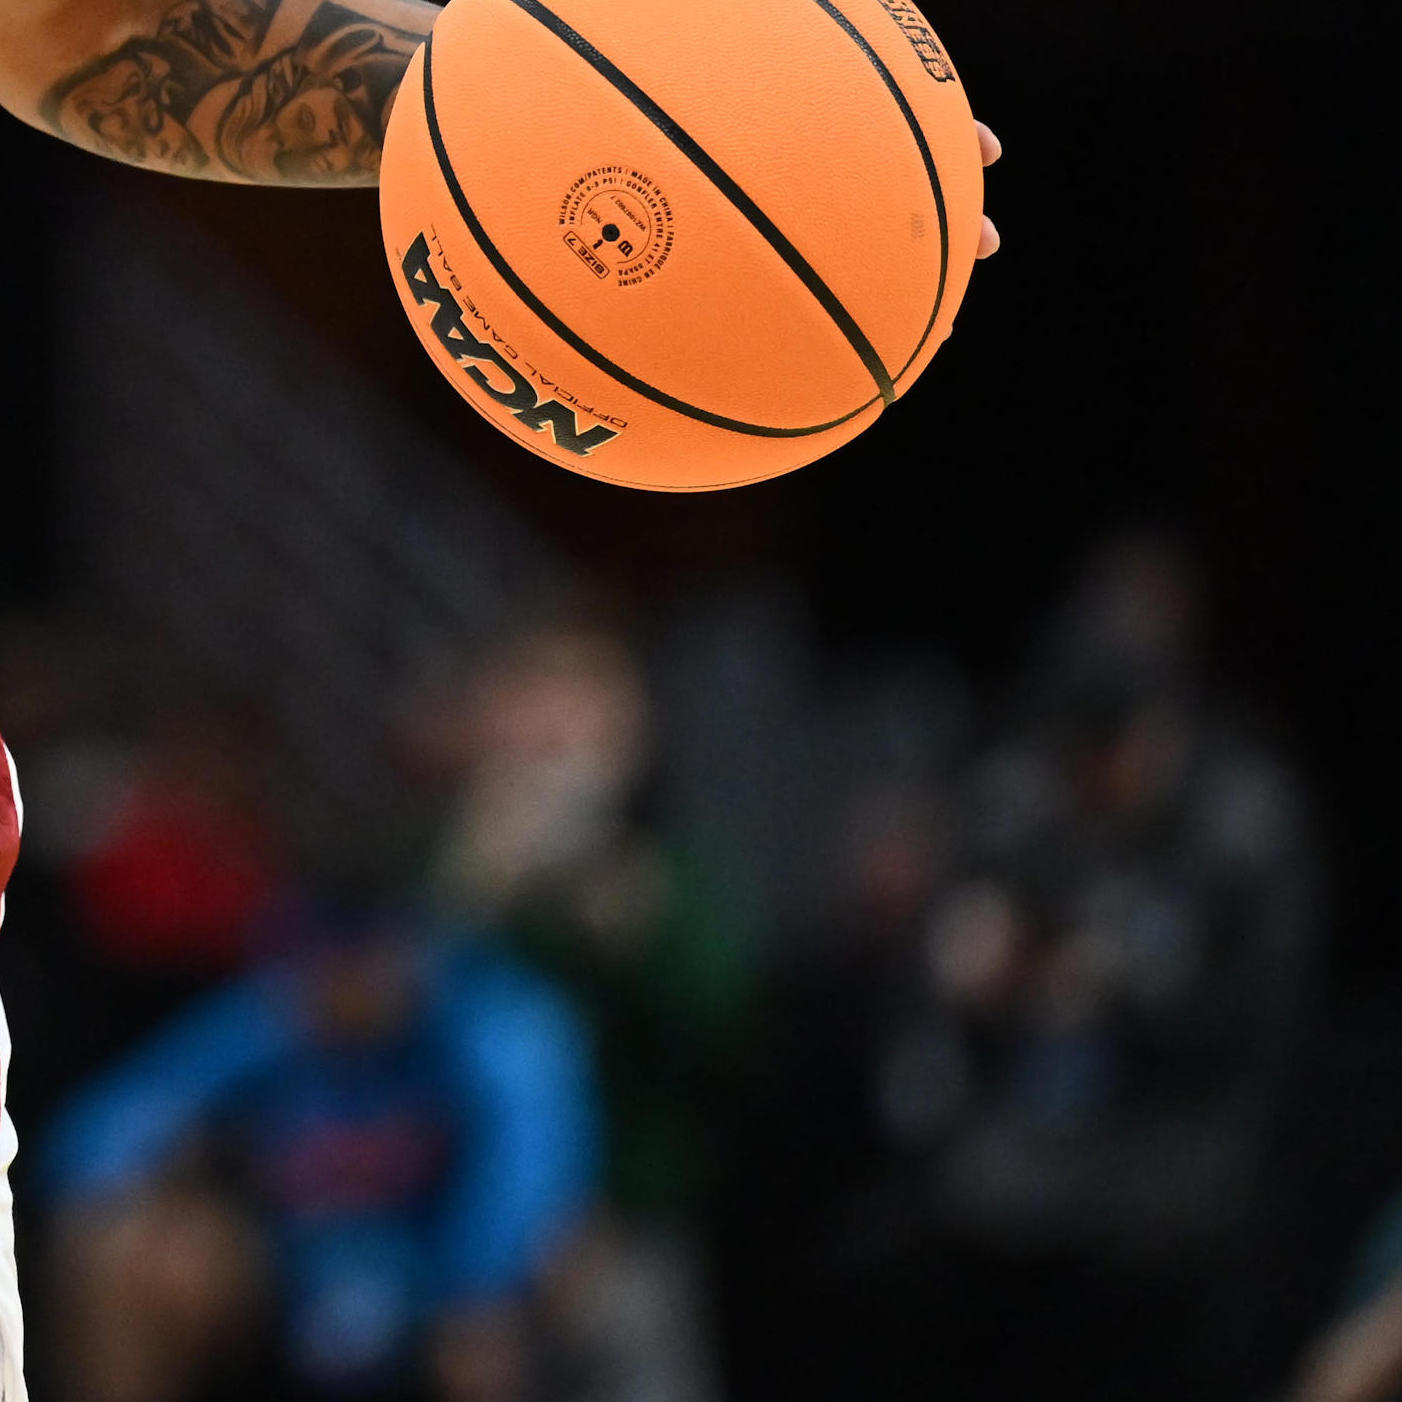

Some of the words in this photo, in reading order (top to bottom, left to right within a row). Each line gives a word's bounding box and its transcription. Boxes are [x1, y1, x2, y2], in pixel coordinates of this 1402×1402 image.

[603, 177, 617, 185] PSI
[631, 170, 652, 188] MADE
[653, 186, 662, 197] IN
[569, 192, 586, 225] INFLATE
[587, 208, 603, 225] NGR
[659, 197, 674, 223] CHINA
[653, 211, 664, 239] ENTRE
[567, 236, 577, 247] 7
[430, 224, 463, 292] BALL
[577, 245, 605, 275] SIZE
[645, 254, 655, 265] ET
[618, 276, 643, 287] CHINE
[644, 268, 655, 279] EN
[462, 295, 518, 360] GAME
[401, 230, 622, 457] NCAA
[524, 361, 629, 429] OFFICIAL
